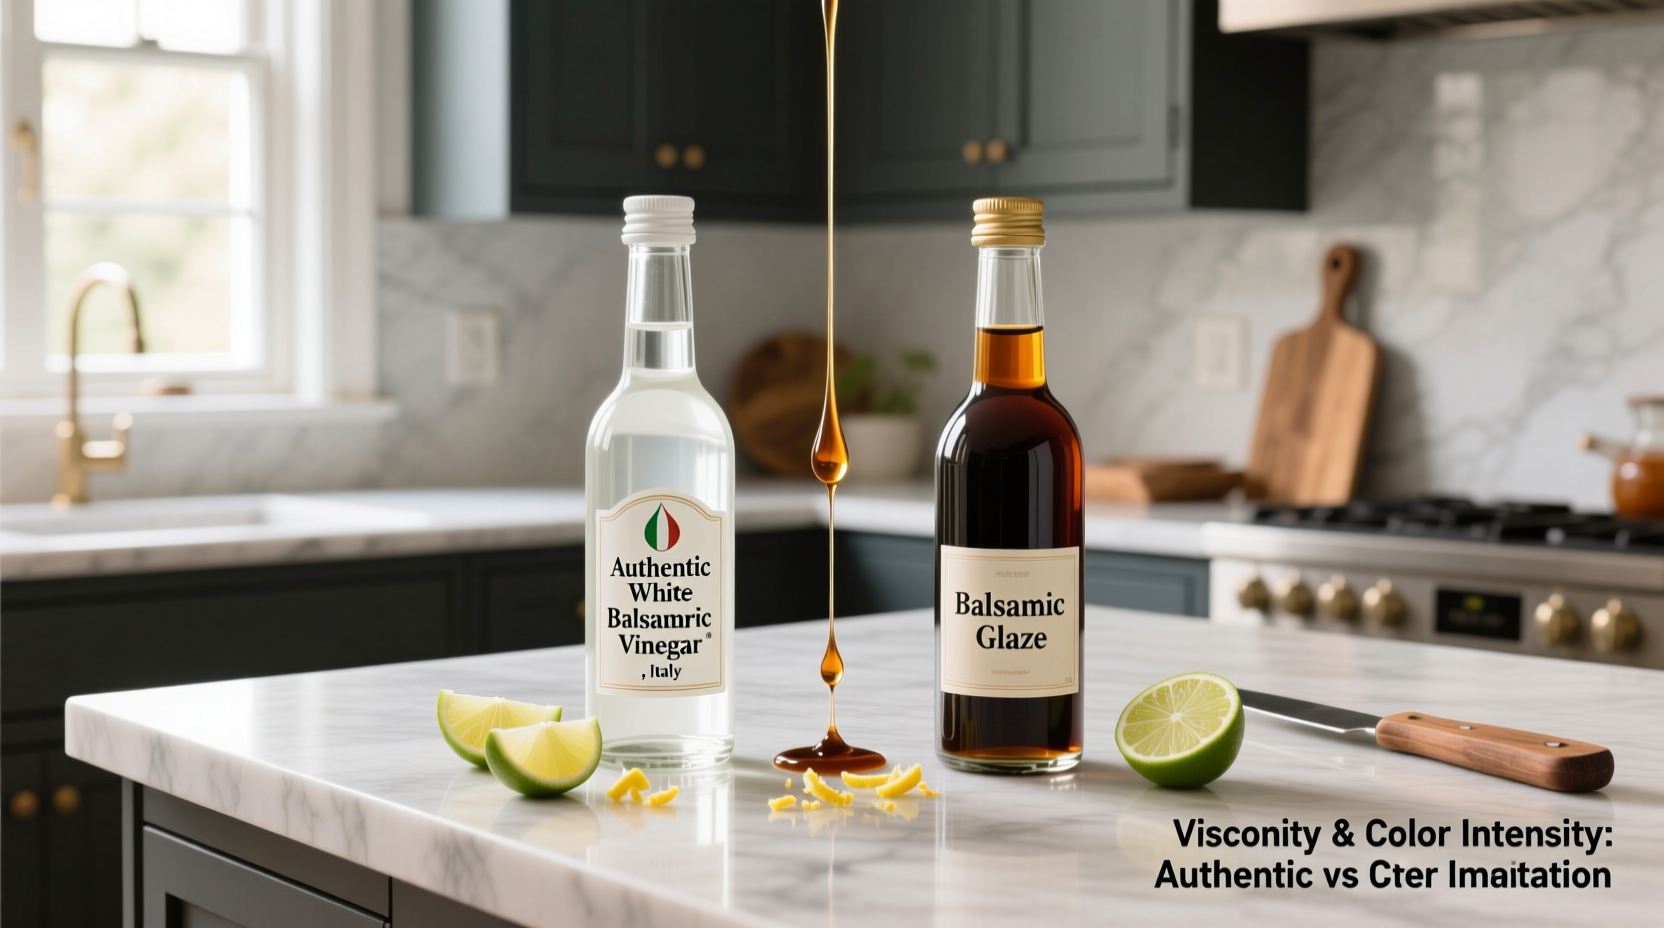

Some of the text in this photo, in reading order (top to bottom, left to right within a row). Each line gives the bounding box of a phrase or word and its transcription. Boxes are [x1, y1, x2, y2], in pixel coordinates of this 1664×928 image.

[610, 555, 711, 577] Authentic
[627, 582, 693, 602] White
[955, 591, 1065, 617] Balsamic
[618, 634, 703, 660] Vinegar
[976, 624, 1047, 650] Glaze
[650, 663, 682, 681] Italy
